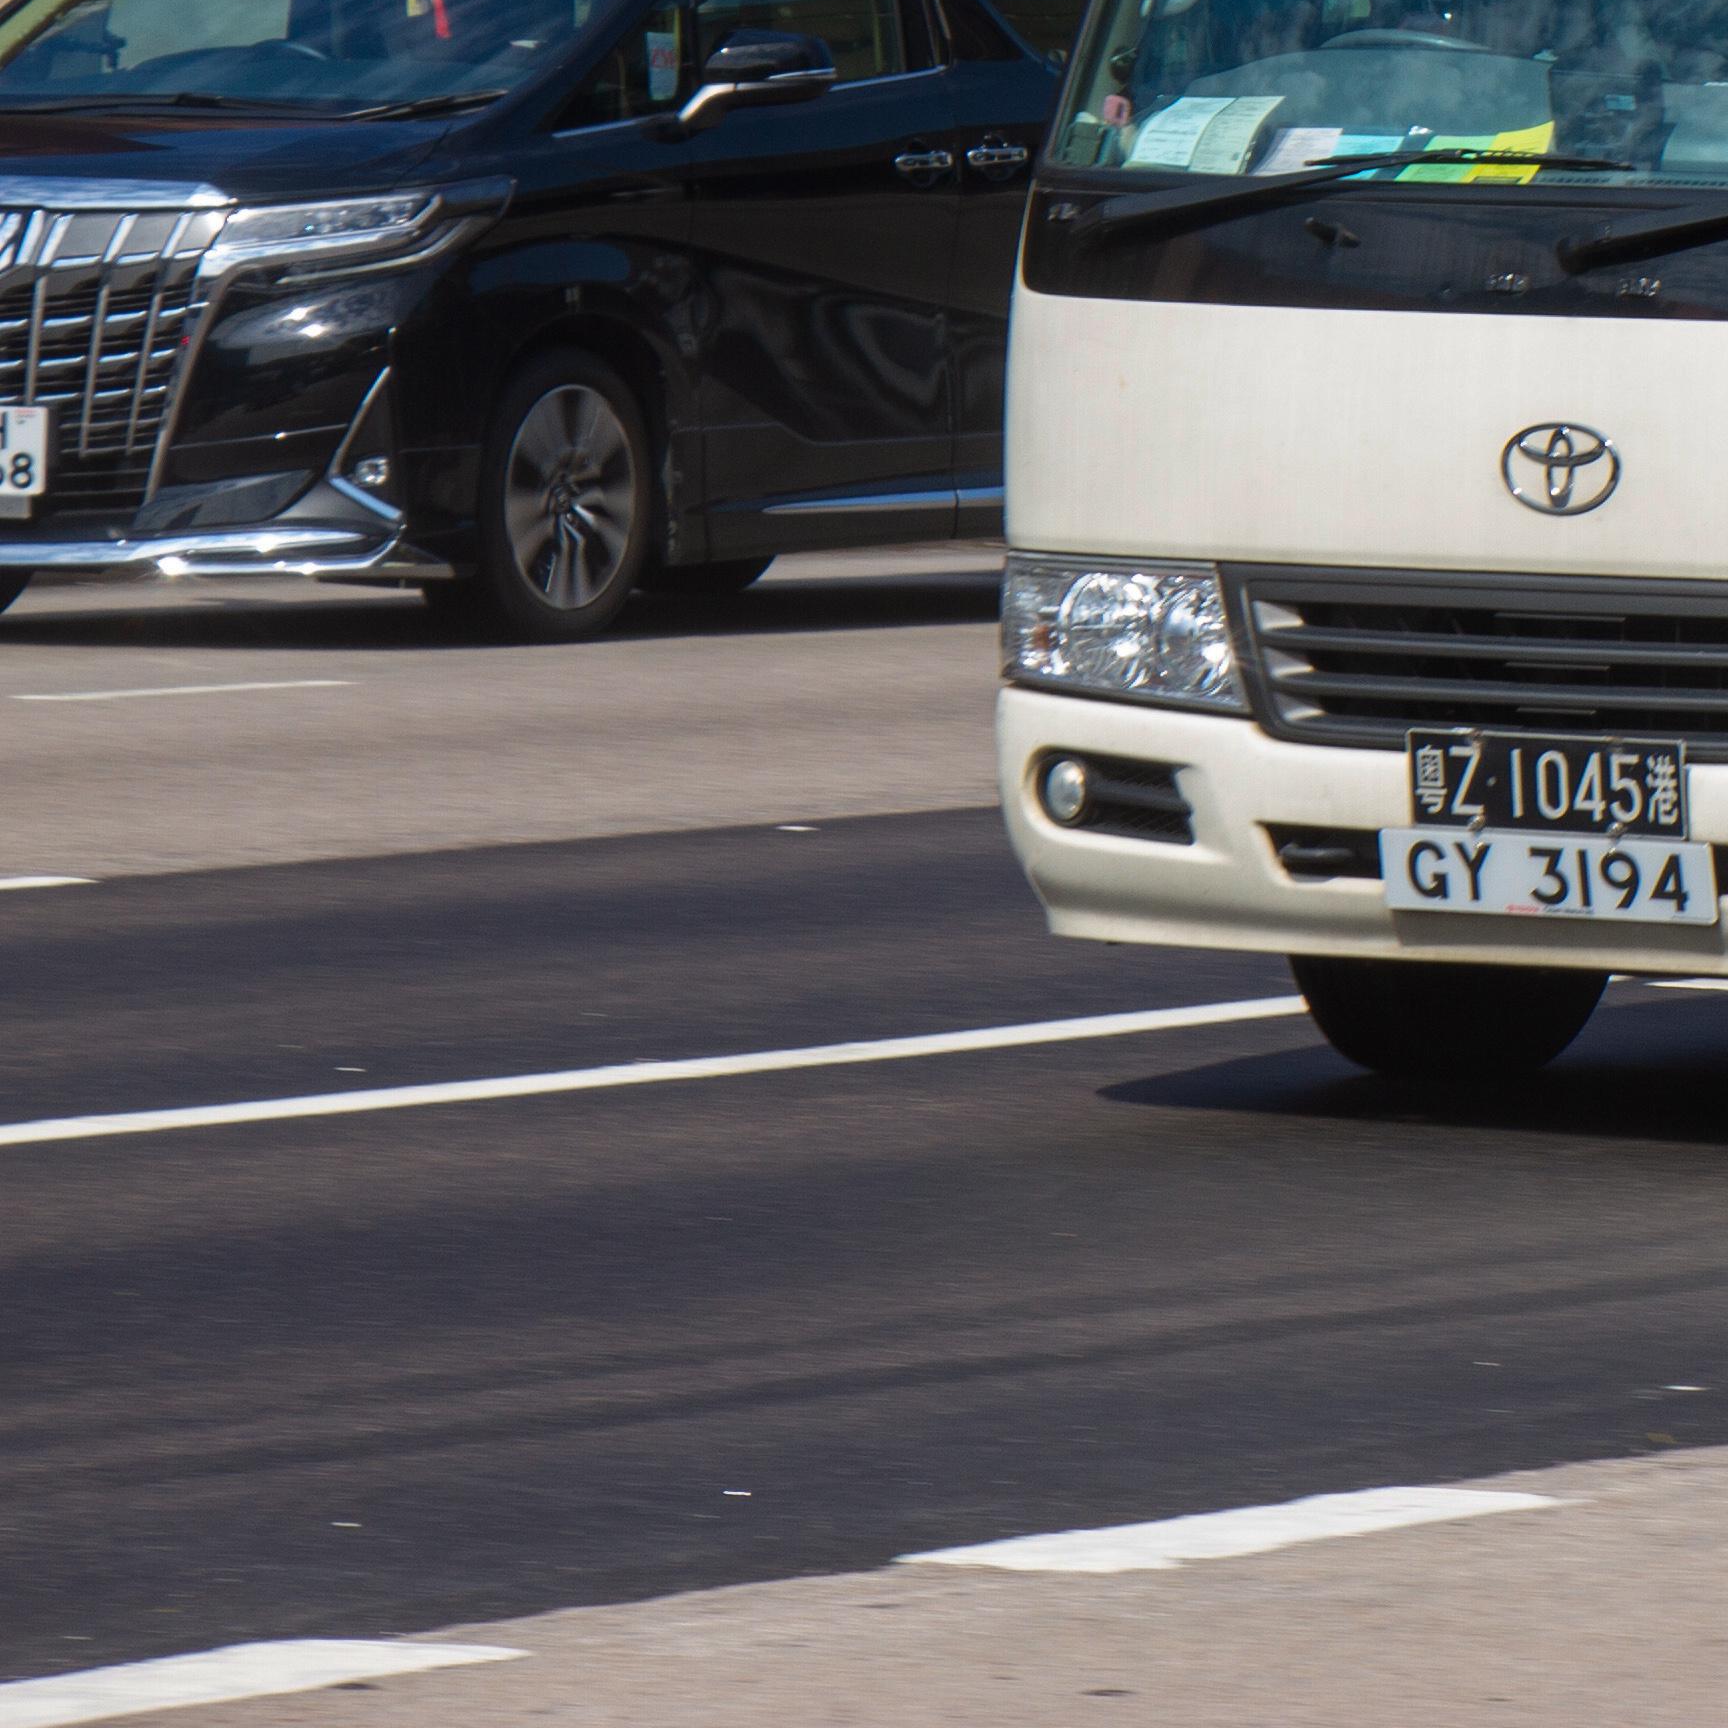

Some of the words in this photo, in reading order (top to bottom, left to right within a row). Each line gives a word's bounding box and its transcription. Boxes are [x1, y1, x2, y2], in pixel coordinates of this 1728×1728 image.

[0, 452, 33, 490] 8
[1408, 840, 1492, 902] GY
[1529, 847, 1689, 913] 3194
